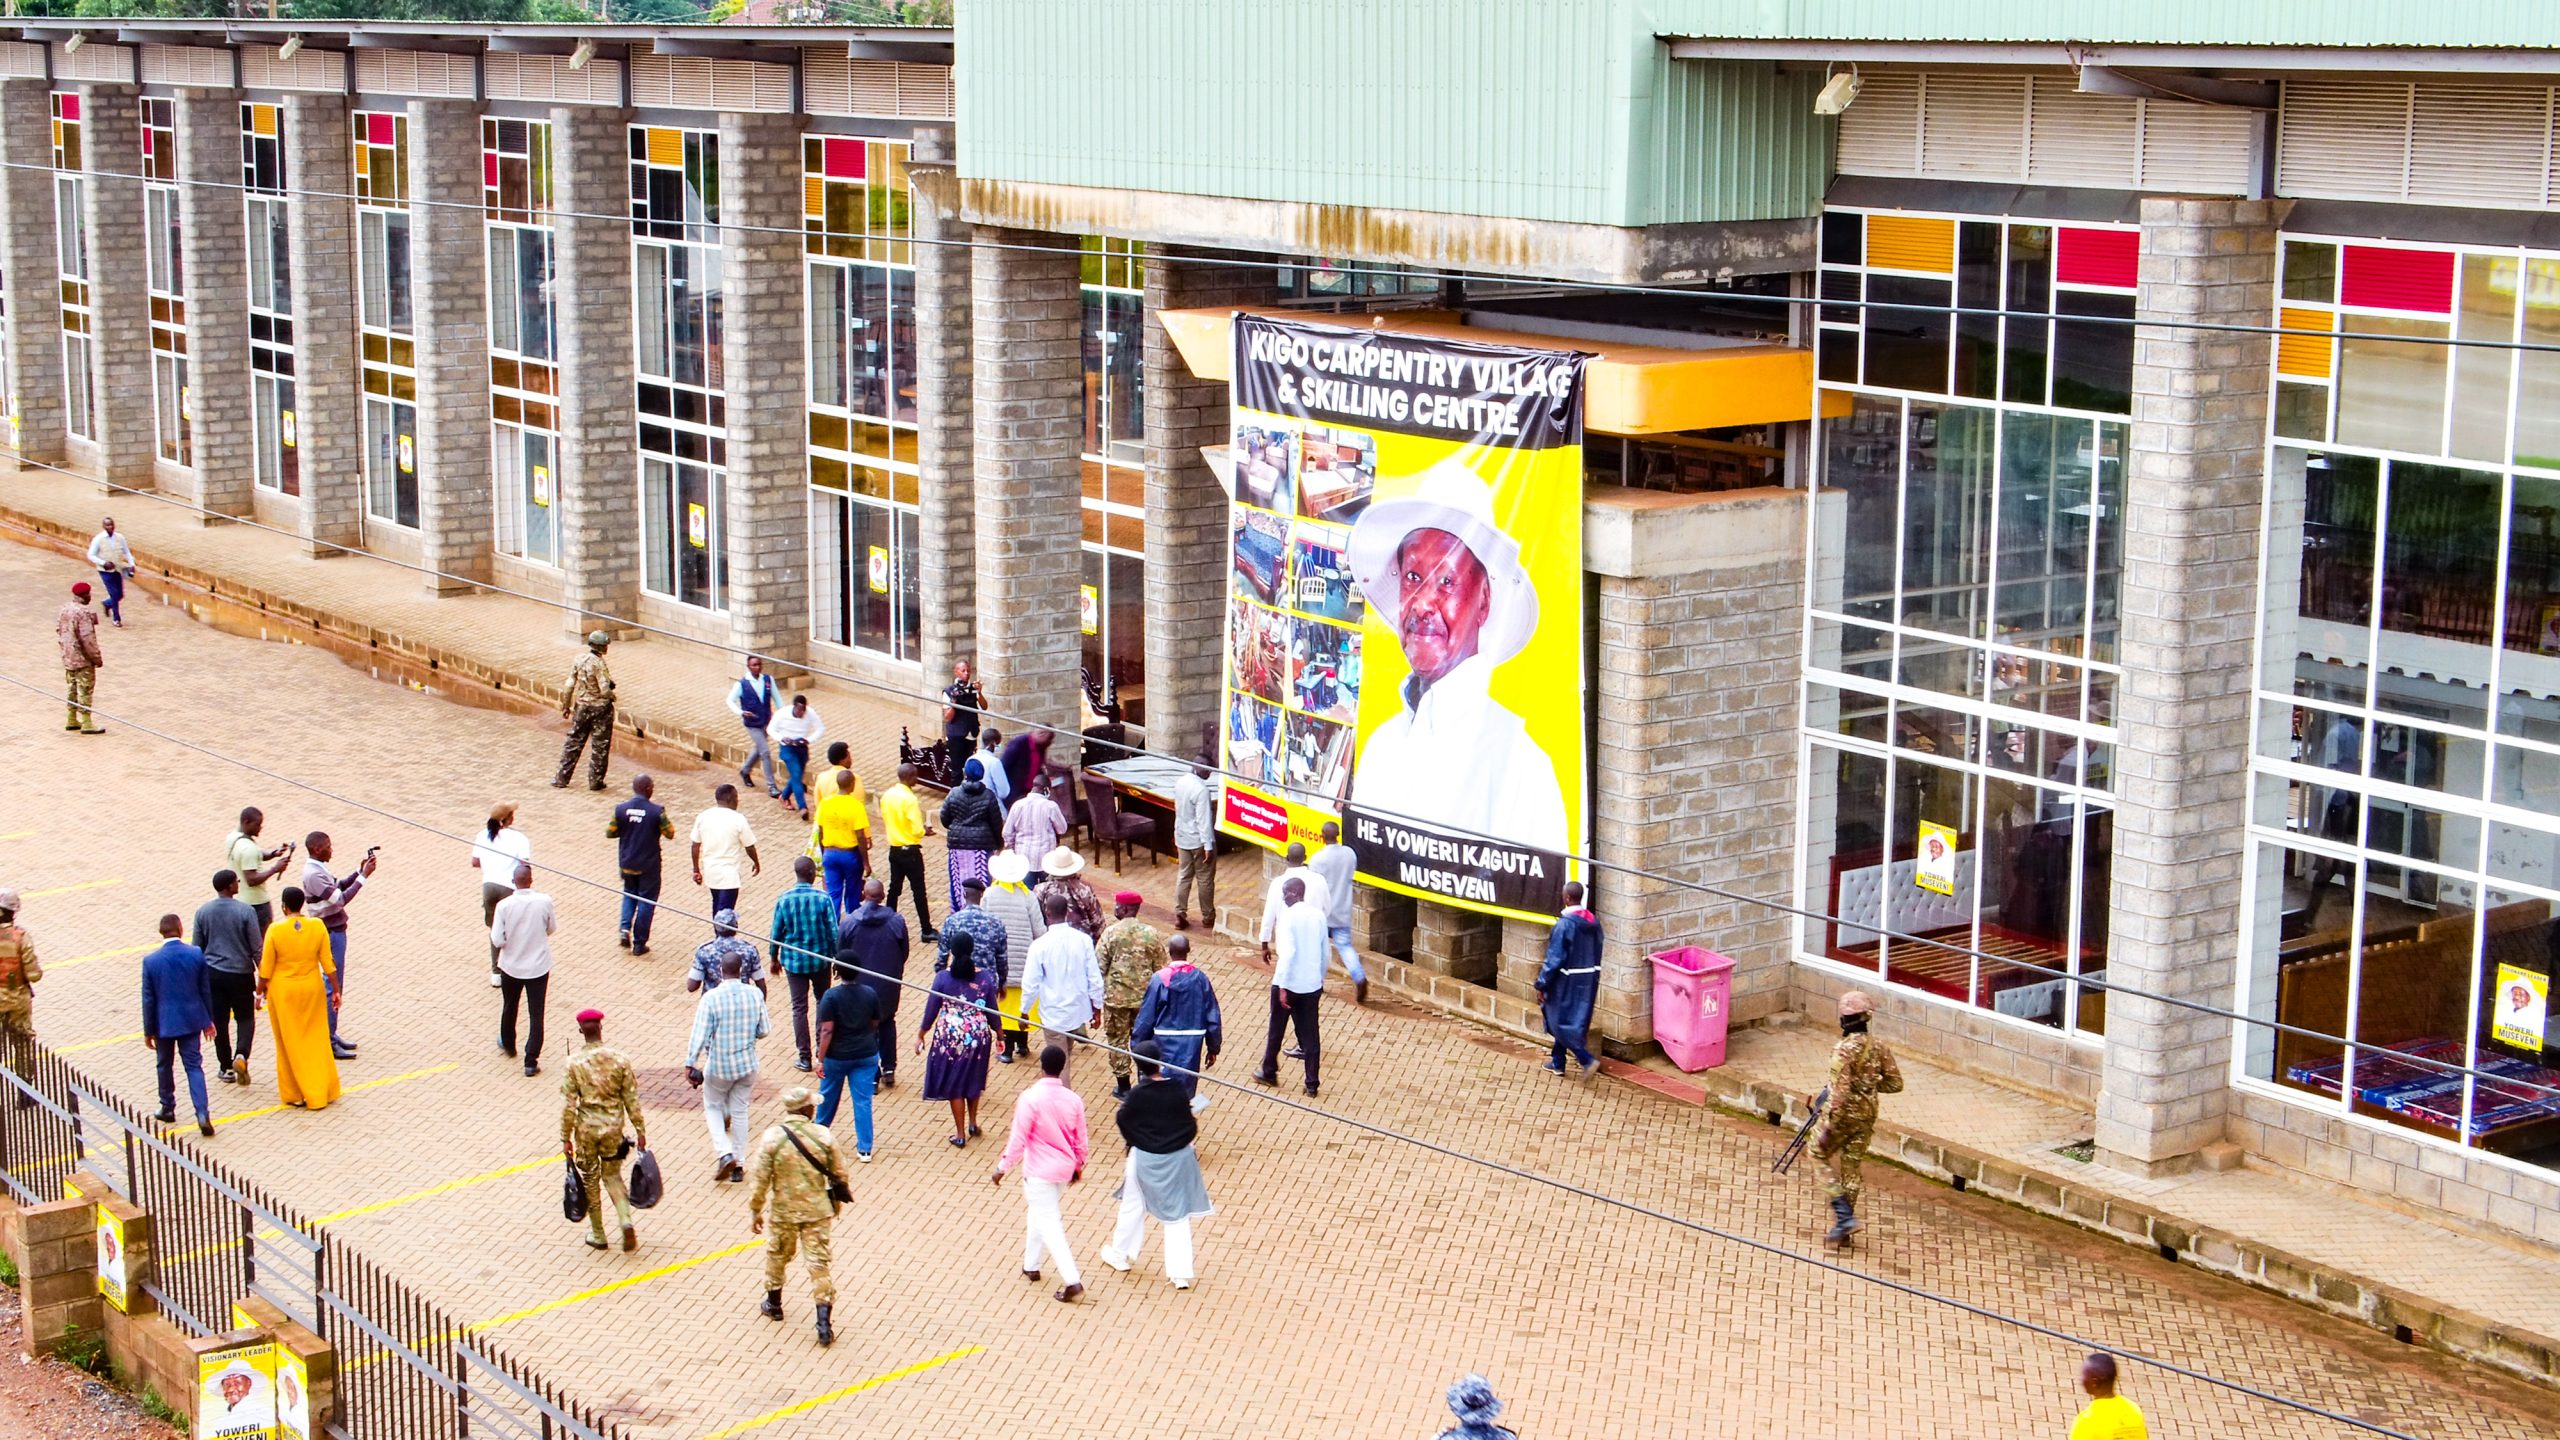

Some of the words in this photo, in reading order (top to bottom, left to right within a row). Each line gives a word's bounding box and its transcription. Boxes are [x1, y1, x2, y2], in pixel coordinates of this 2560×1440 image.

[1250, 330, 1309, 363] KIGO
[1312, 342, 1469, 389] CARPENTRY
[1471, 361, 1573, 398] VILLAGE
[1278, 373, 1298, 404] &
[1302, 379, 1409, 422] SKILLING
[1412, 392, 1519, 436] CENTRE
[1385, 826, 1459, 863] YOWERI
[1463, 844, 1544, 878] KAGUTA
[1400, 862, 1496, 902] MUSEVENI
[1920, 876, 1949, 891] MUSEVENI
[2498, 1028, 2538, 1047] MUSEVENI
[2504, 1022, 2534, 1036] YOWERI
[202, 1352, 243, 1364] VISIONARY
[245, 1346, 272, 1358] LEADER
[215, 1422, 260, 1438] YOWERI
